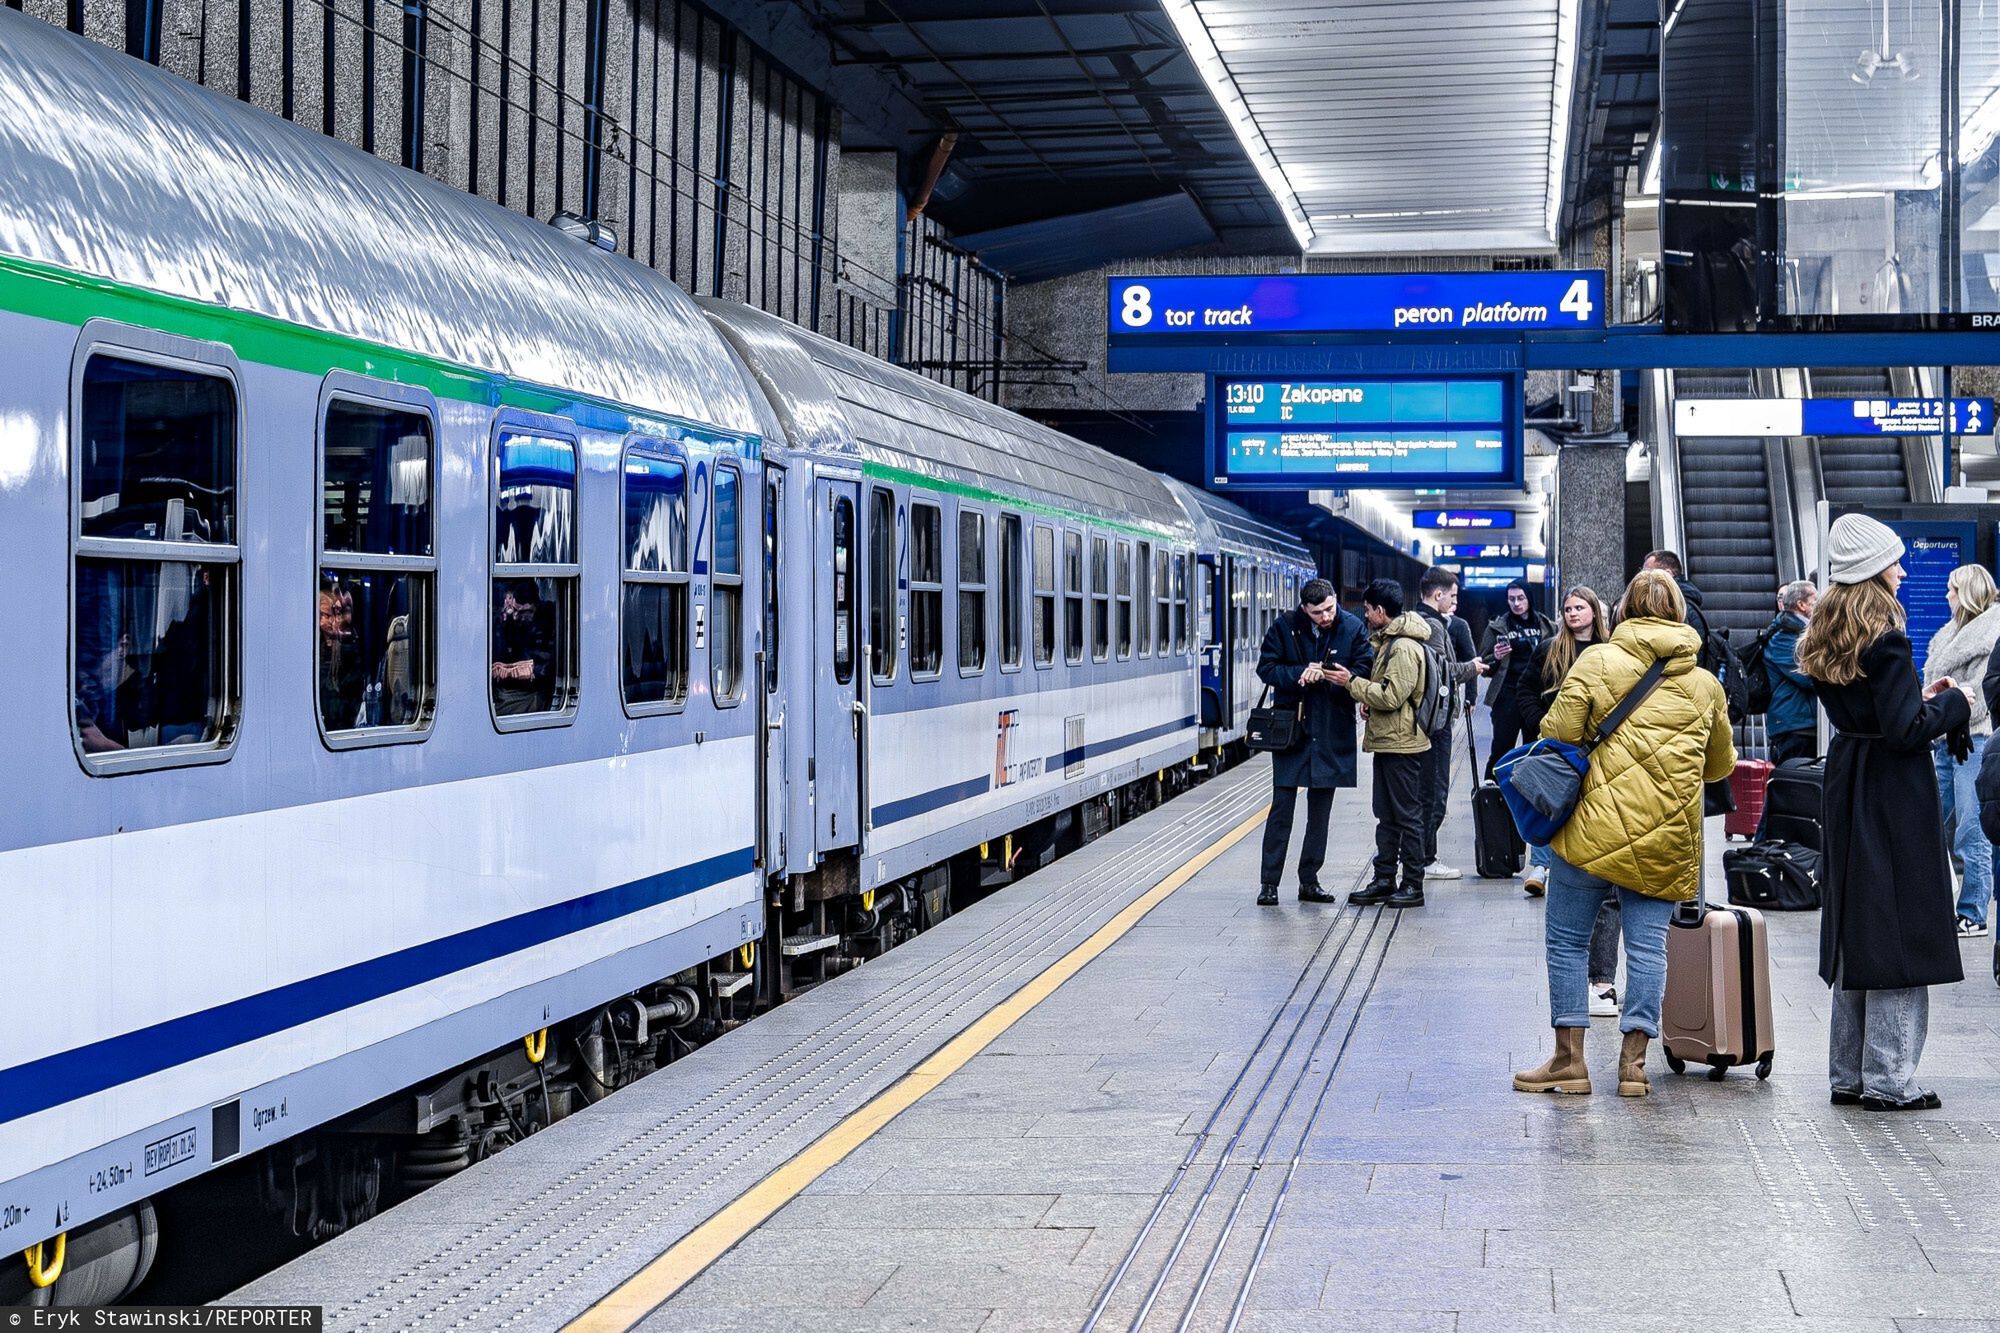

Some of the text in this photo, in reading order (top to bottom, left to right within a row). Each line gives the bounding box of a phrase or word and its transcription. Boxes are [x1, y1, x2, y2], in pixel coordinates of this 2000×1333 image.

[1121, 285, 1253, 327] 8 tor track
[1394, 279, 1593, 328] peron platform 4
[1226, 384, 1363, 404] 13:10 Zakopane
[1280, 406, 1293, 420] IC
[1922, 402, 1930, 416] 1
[1933, 402, 1943, 416] 2
[1232, 448, 1236, 456] 1
[1245, 448, 1250, 456] 2
[693, 460, 708, 575] 2
[1436, 512, 1447, 527] 4
[898, 504, 907, 589] 2
[1913, 540, 1958, 550] Departures
[253, 1107, 277, 1131] Ogrzew.
